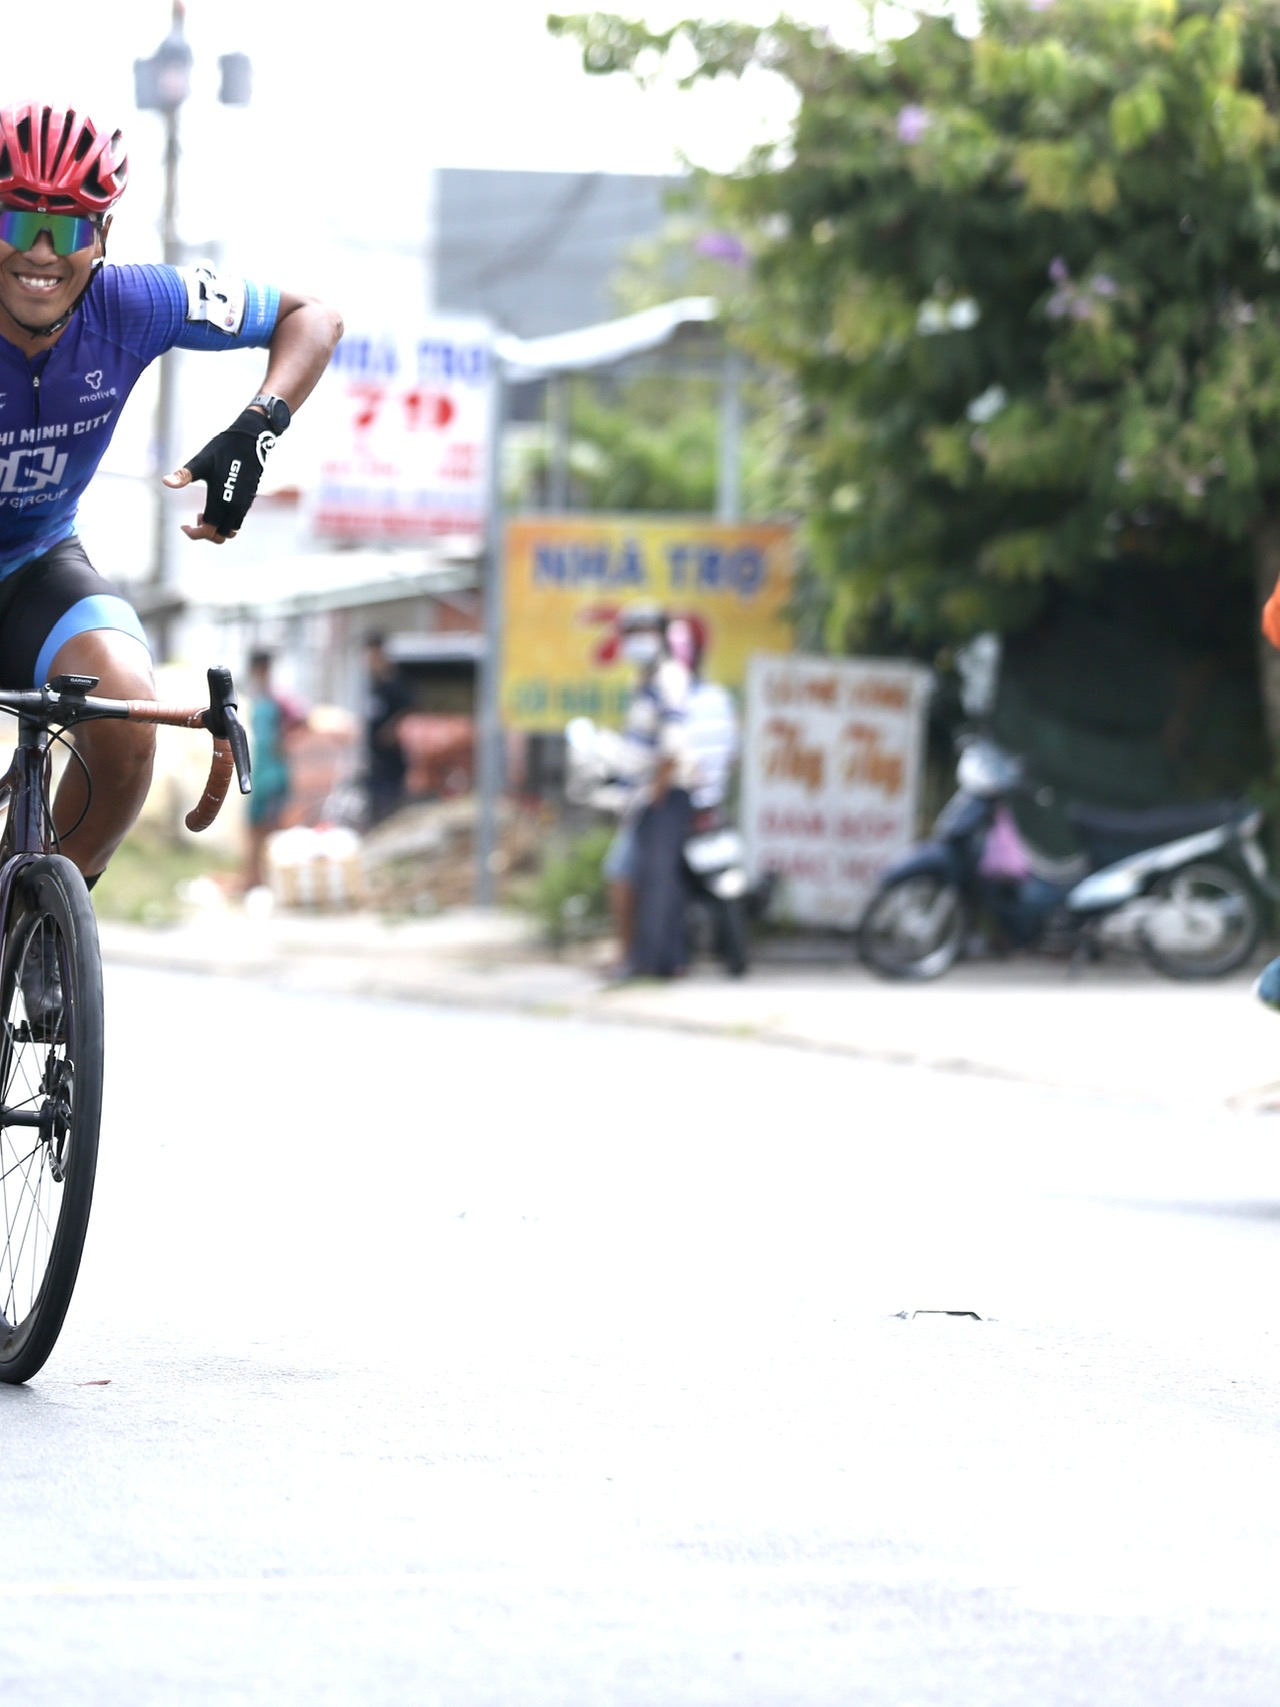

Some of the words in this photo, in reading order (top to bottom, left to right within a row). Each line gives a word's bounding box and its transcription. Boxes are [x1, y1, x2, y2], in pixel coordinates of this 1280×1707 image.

[19, 423, 68, 443] MINH
[73, 410, 112, 435] CITY
[9, 488, 69, 509] GROUP
